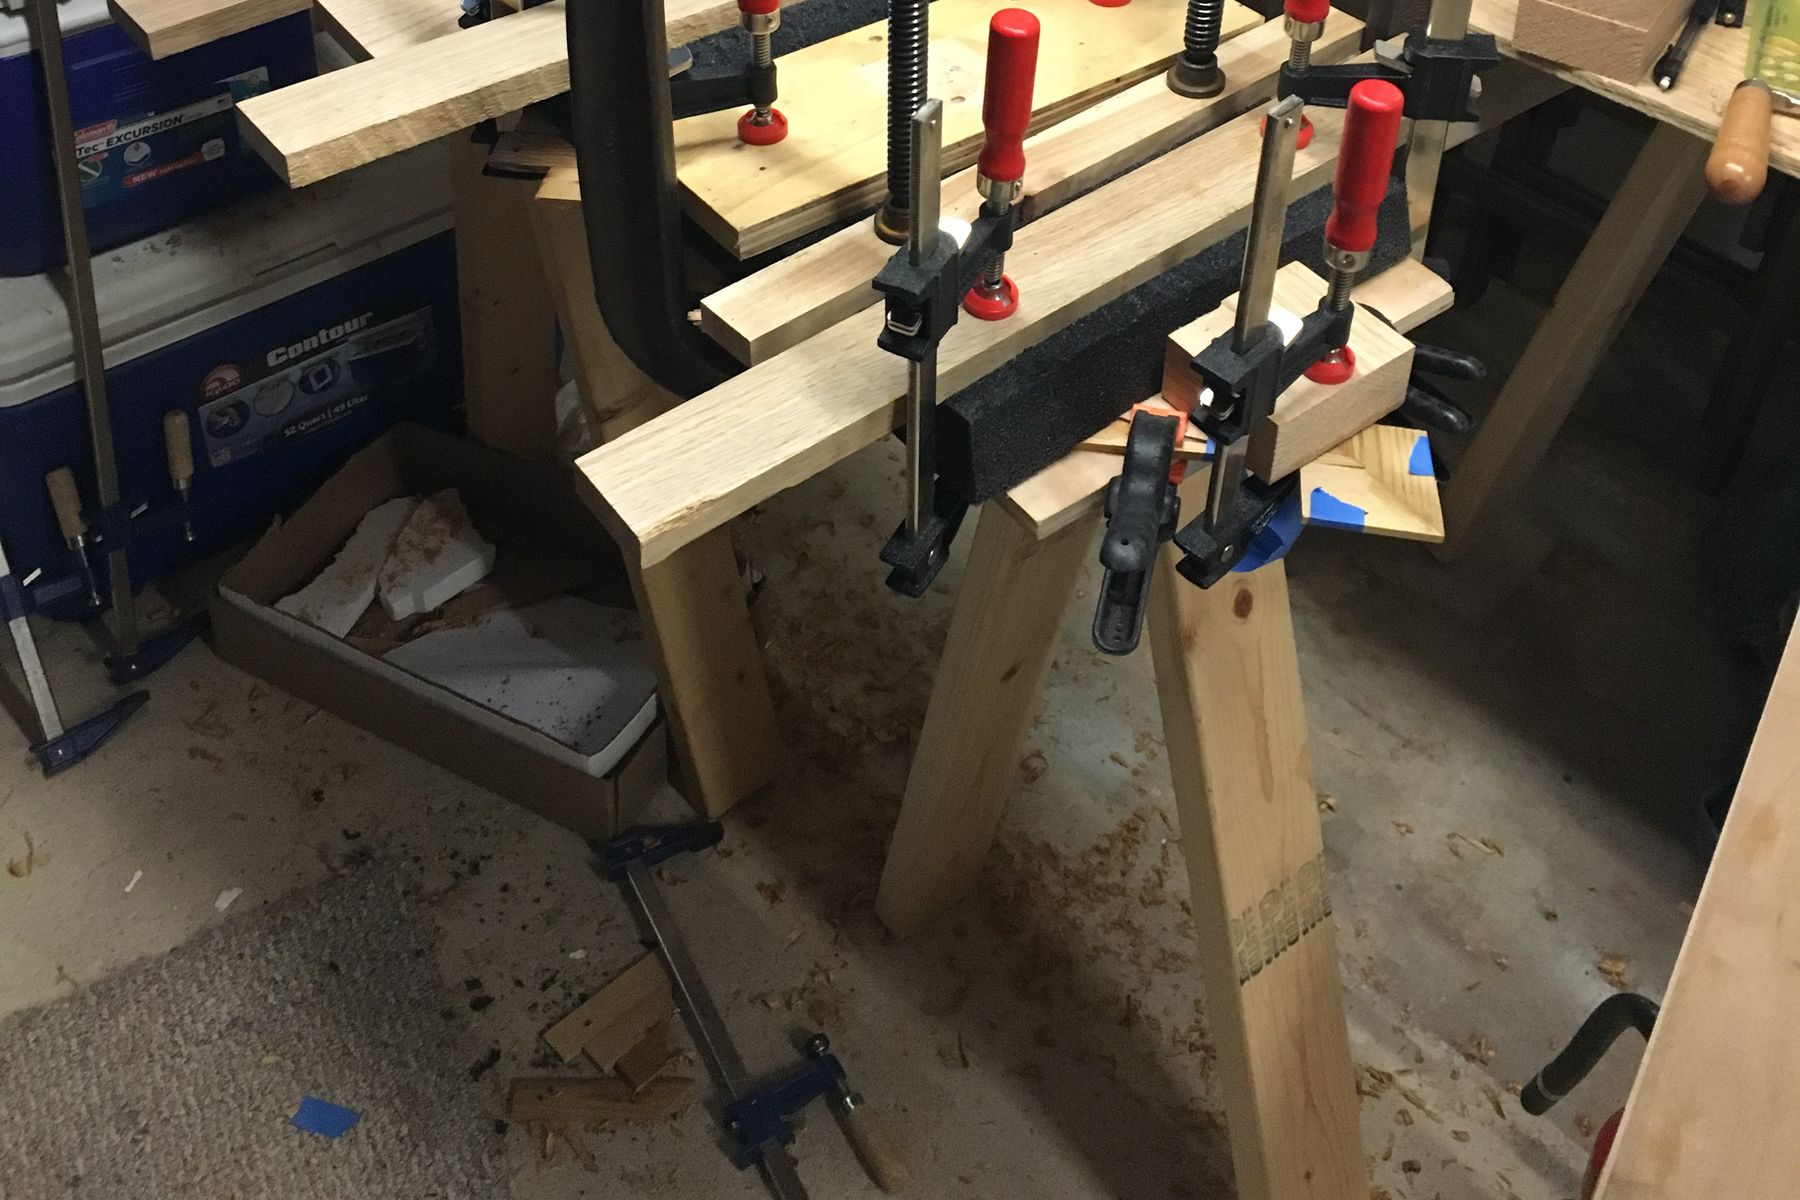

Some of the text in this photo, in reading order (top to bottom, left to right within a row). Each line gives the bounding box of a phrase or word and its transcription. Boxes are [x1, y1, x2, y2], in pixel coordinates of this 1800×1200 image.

[106, 114, 185, 148] EXCURSION
[131, 169, 159, 184] NEW
[266, 311, 374, 368] Contour
